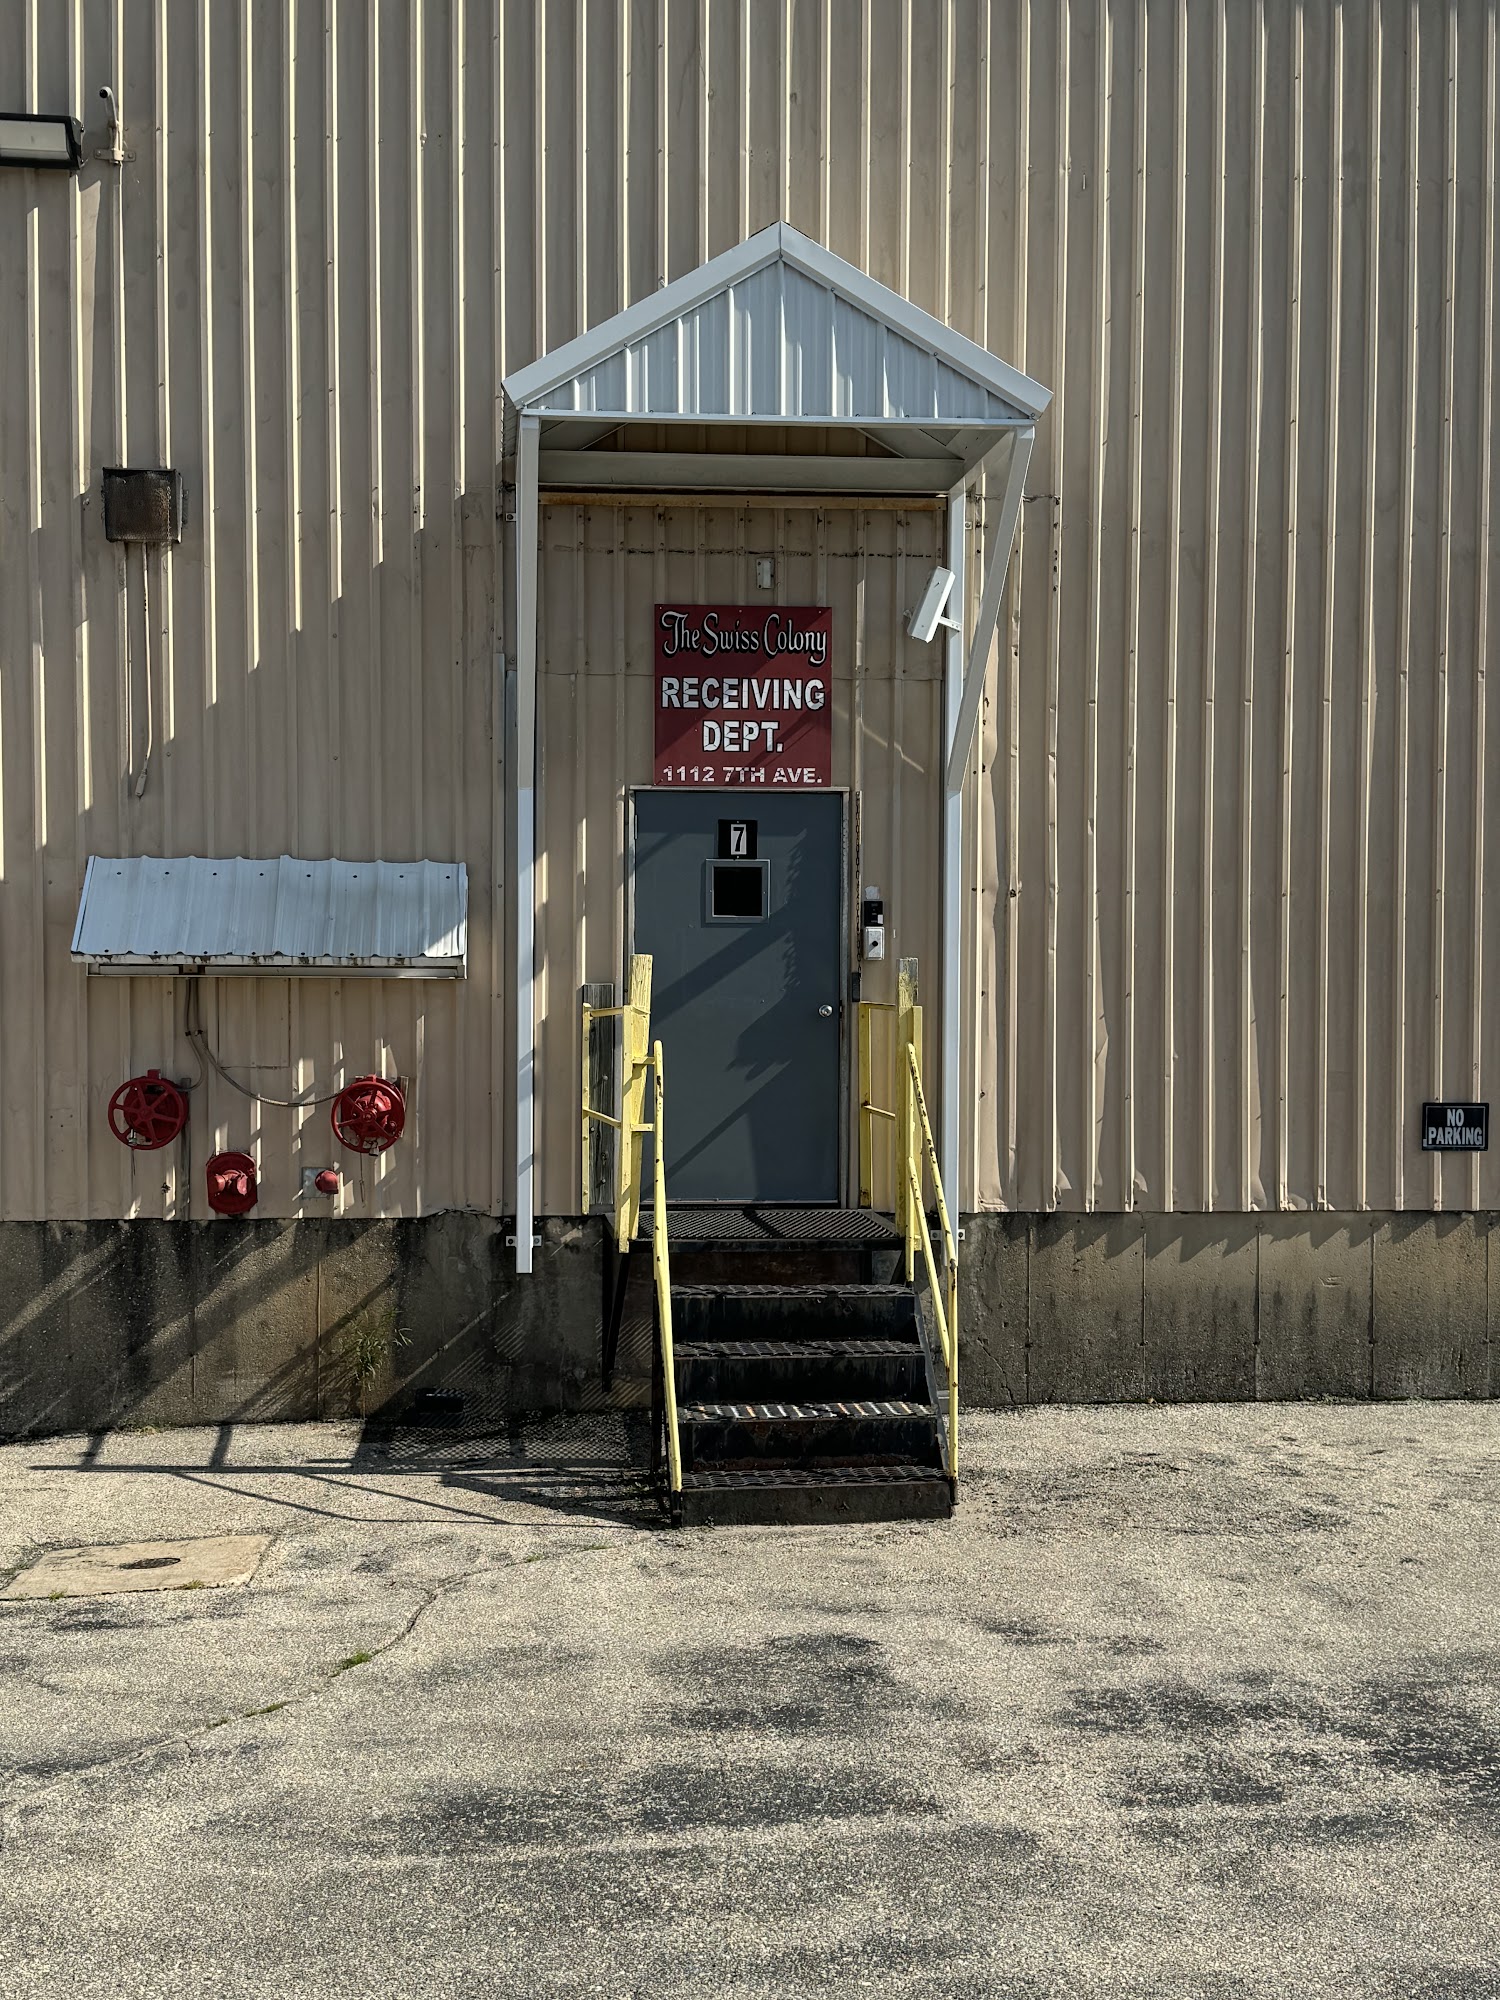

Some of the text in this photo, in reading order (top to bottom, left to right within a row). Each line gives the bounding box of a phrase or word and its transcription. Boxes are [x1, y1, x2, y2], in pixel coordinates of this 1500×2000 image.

[661, 610, 828, 667] The Swiss Colony
[661, 677, 825, 710] RECEIVING
[703, 720, 784, 752] DEPT.
[663, 765, 823, 784] 1112 7TH AVE.
[733, 826, 745, 852] 7
[1446, 1108, 1465, 1127] NO
[1428, 1127, 1483, 1145] PARKING
